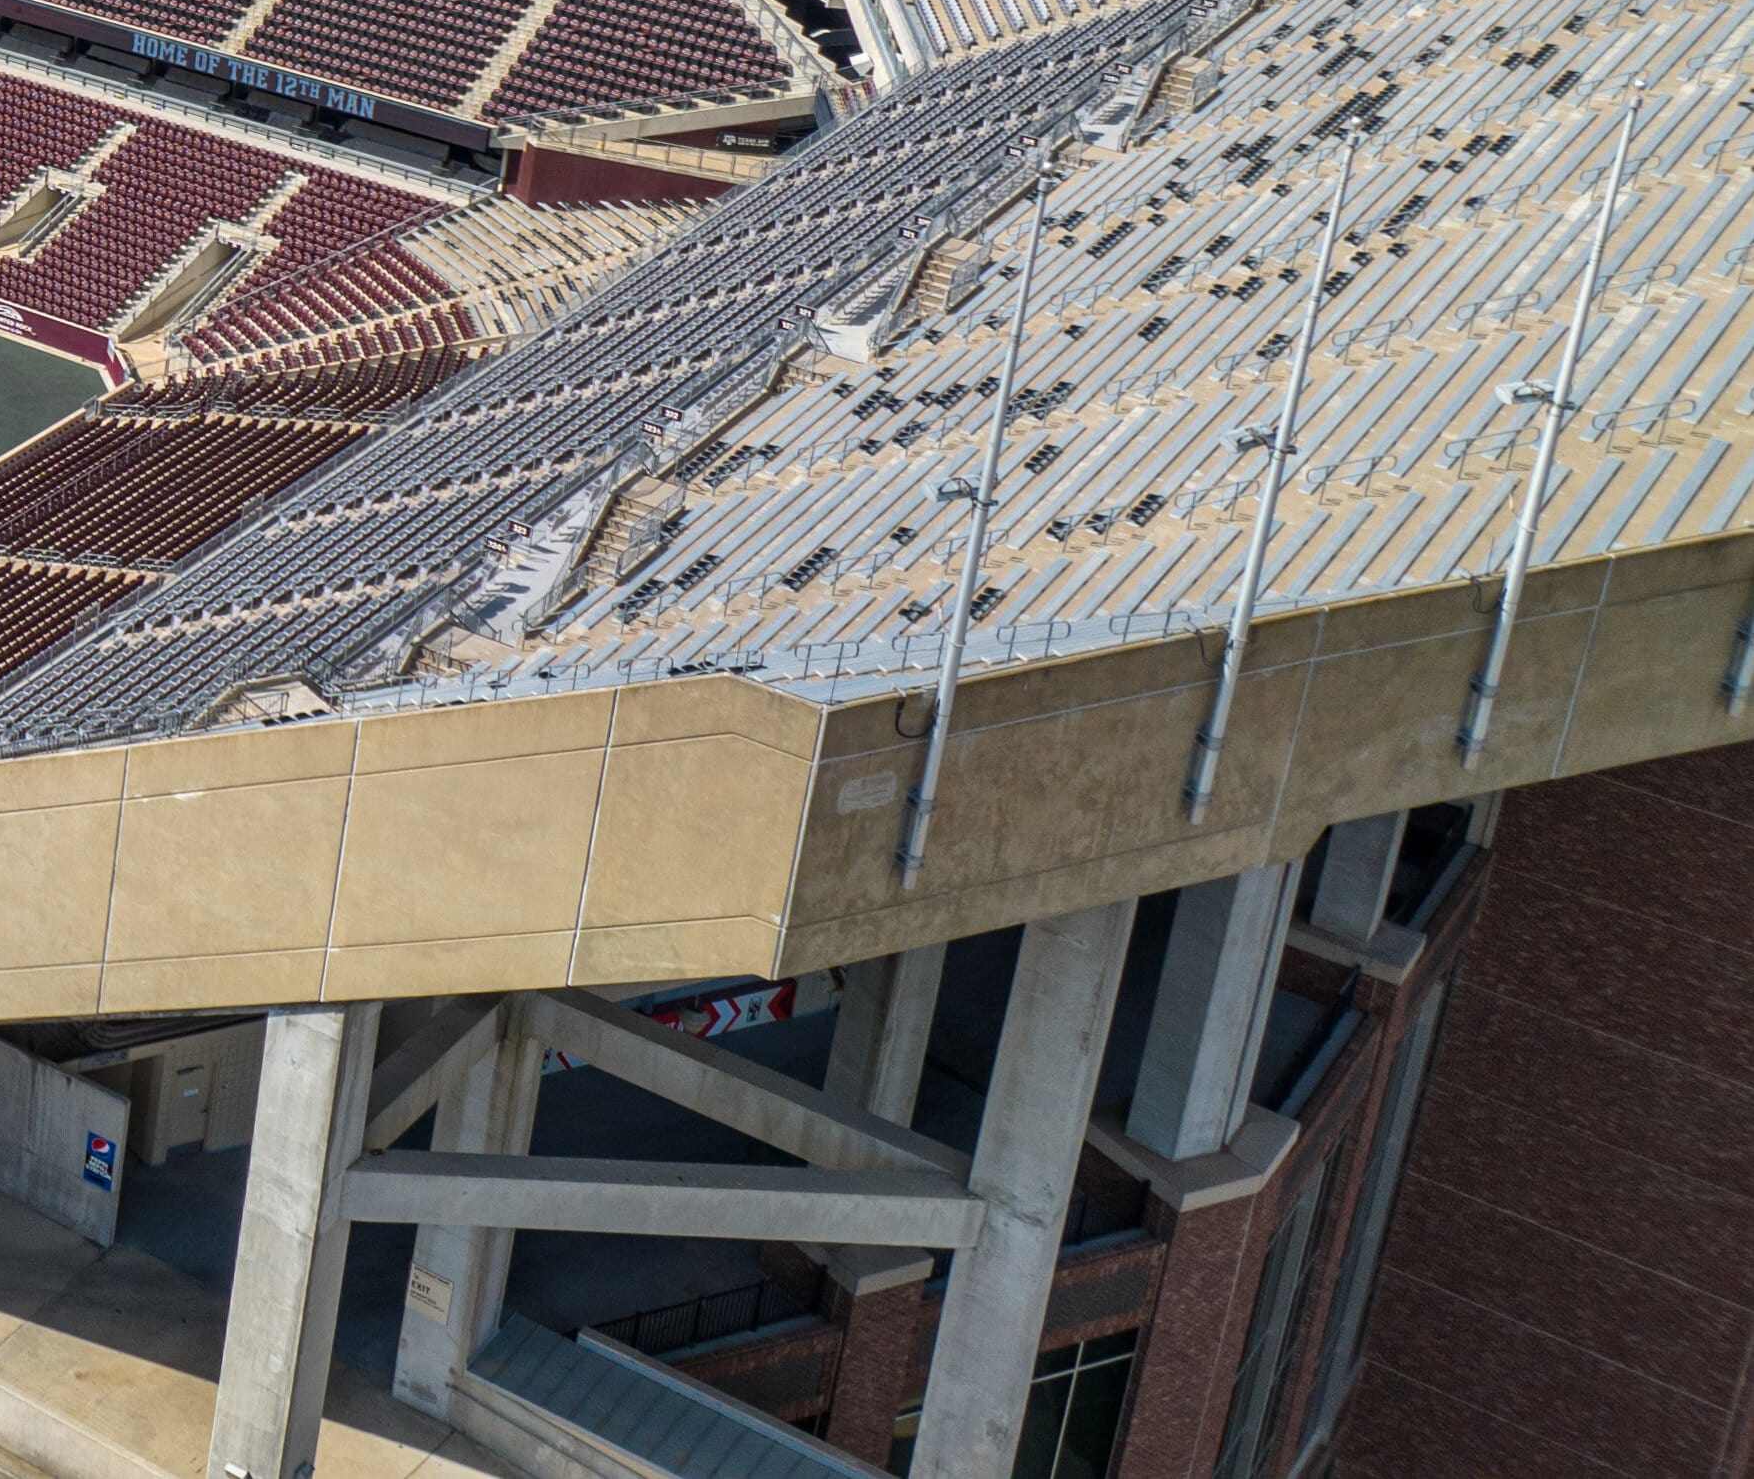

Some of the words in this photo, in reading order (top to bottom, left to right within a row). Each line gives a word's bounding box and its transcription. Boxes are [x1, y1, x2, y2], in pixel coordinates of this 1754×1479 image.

[132, 33, 188, 67] HOME
[195, 51, 220, 75] OF
[227, 59, 269, 89] THE
[276, 73, 320, 99] 12TH
[326, 87, 376, 120] MAN
